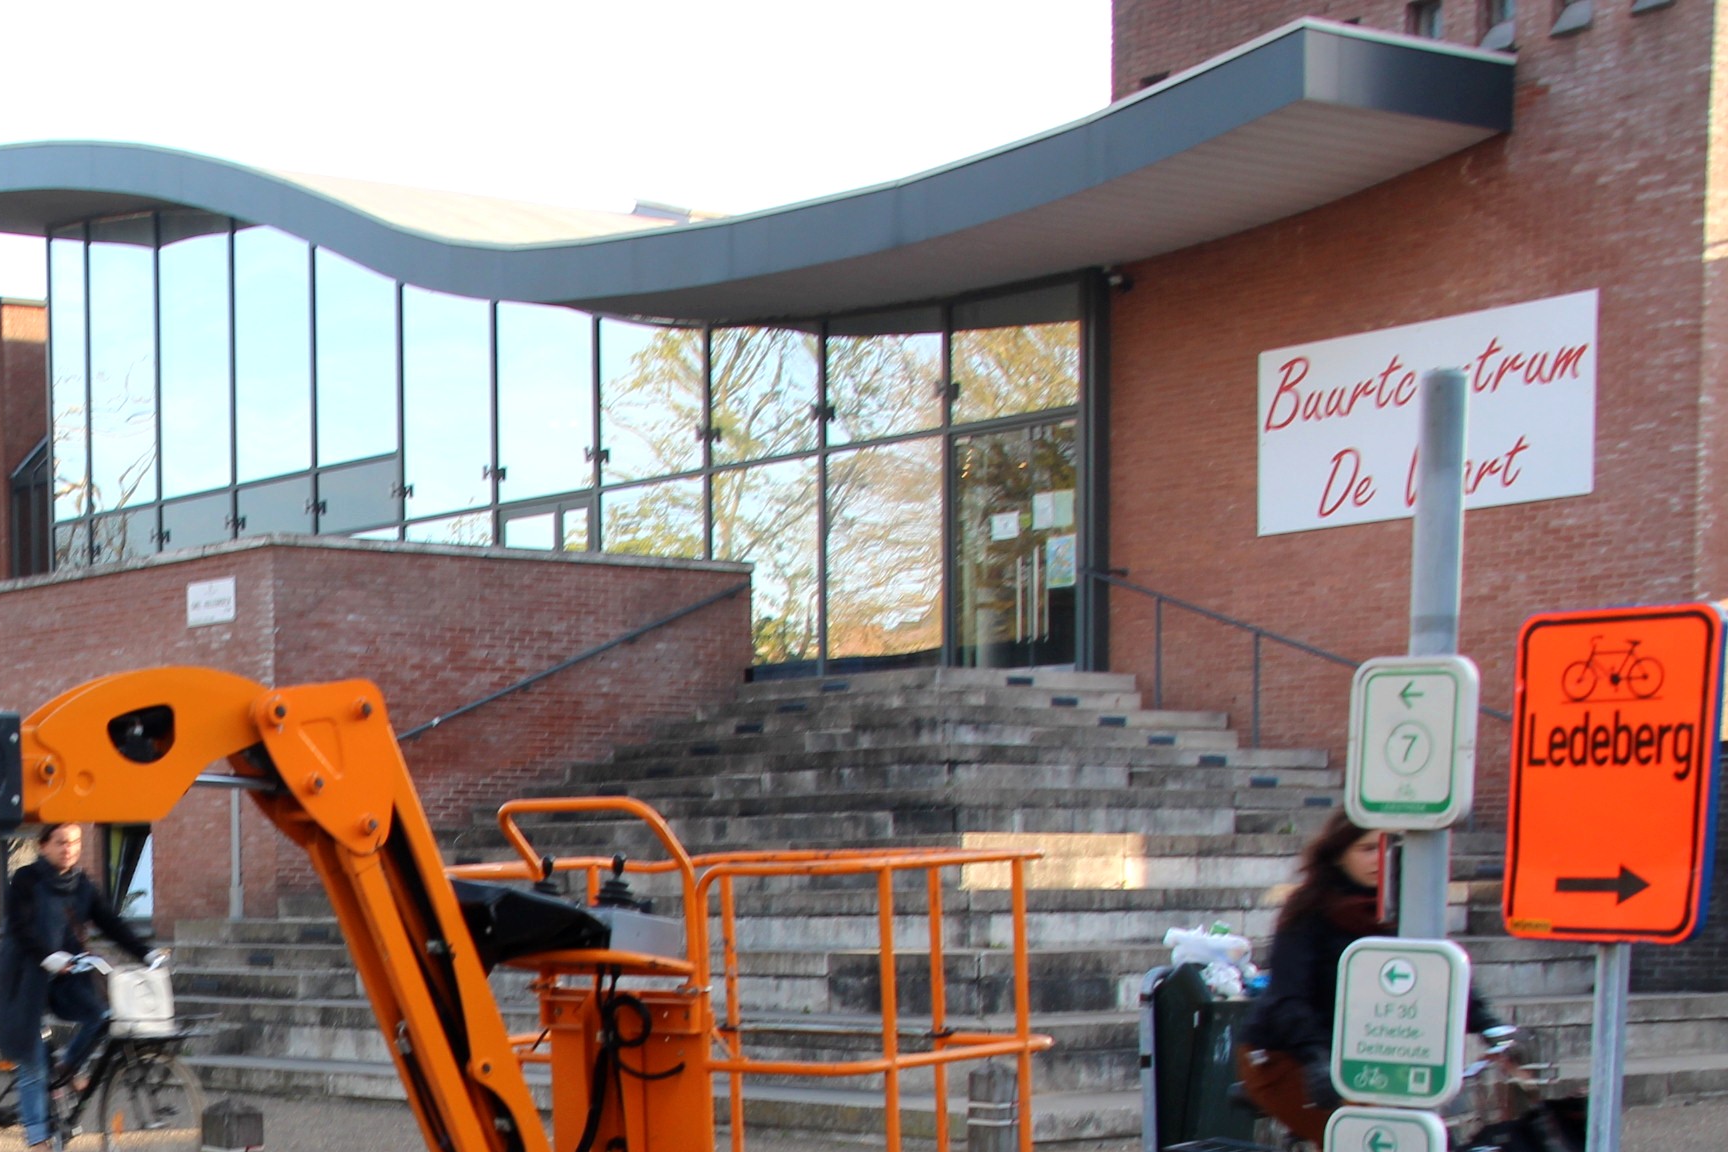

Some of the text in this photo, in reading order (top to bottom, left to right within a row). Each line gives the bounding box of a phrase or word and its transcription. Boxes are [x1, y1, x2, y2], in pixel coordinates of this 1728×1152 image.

[1265, 335, 1590, 432] Buurtctrum
[1318, 448, 1376, 518] De
[1401, 734, 1419, 763] 7
[1527, 709, 1694, 781] Ledeberg
[1374, 1003, 1418, 1020] LF 30
